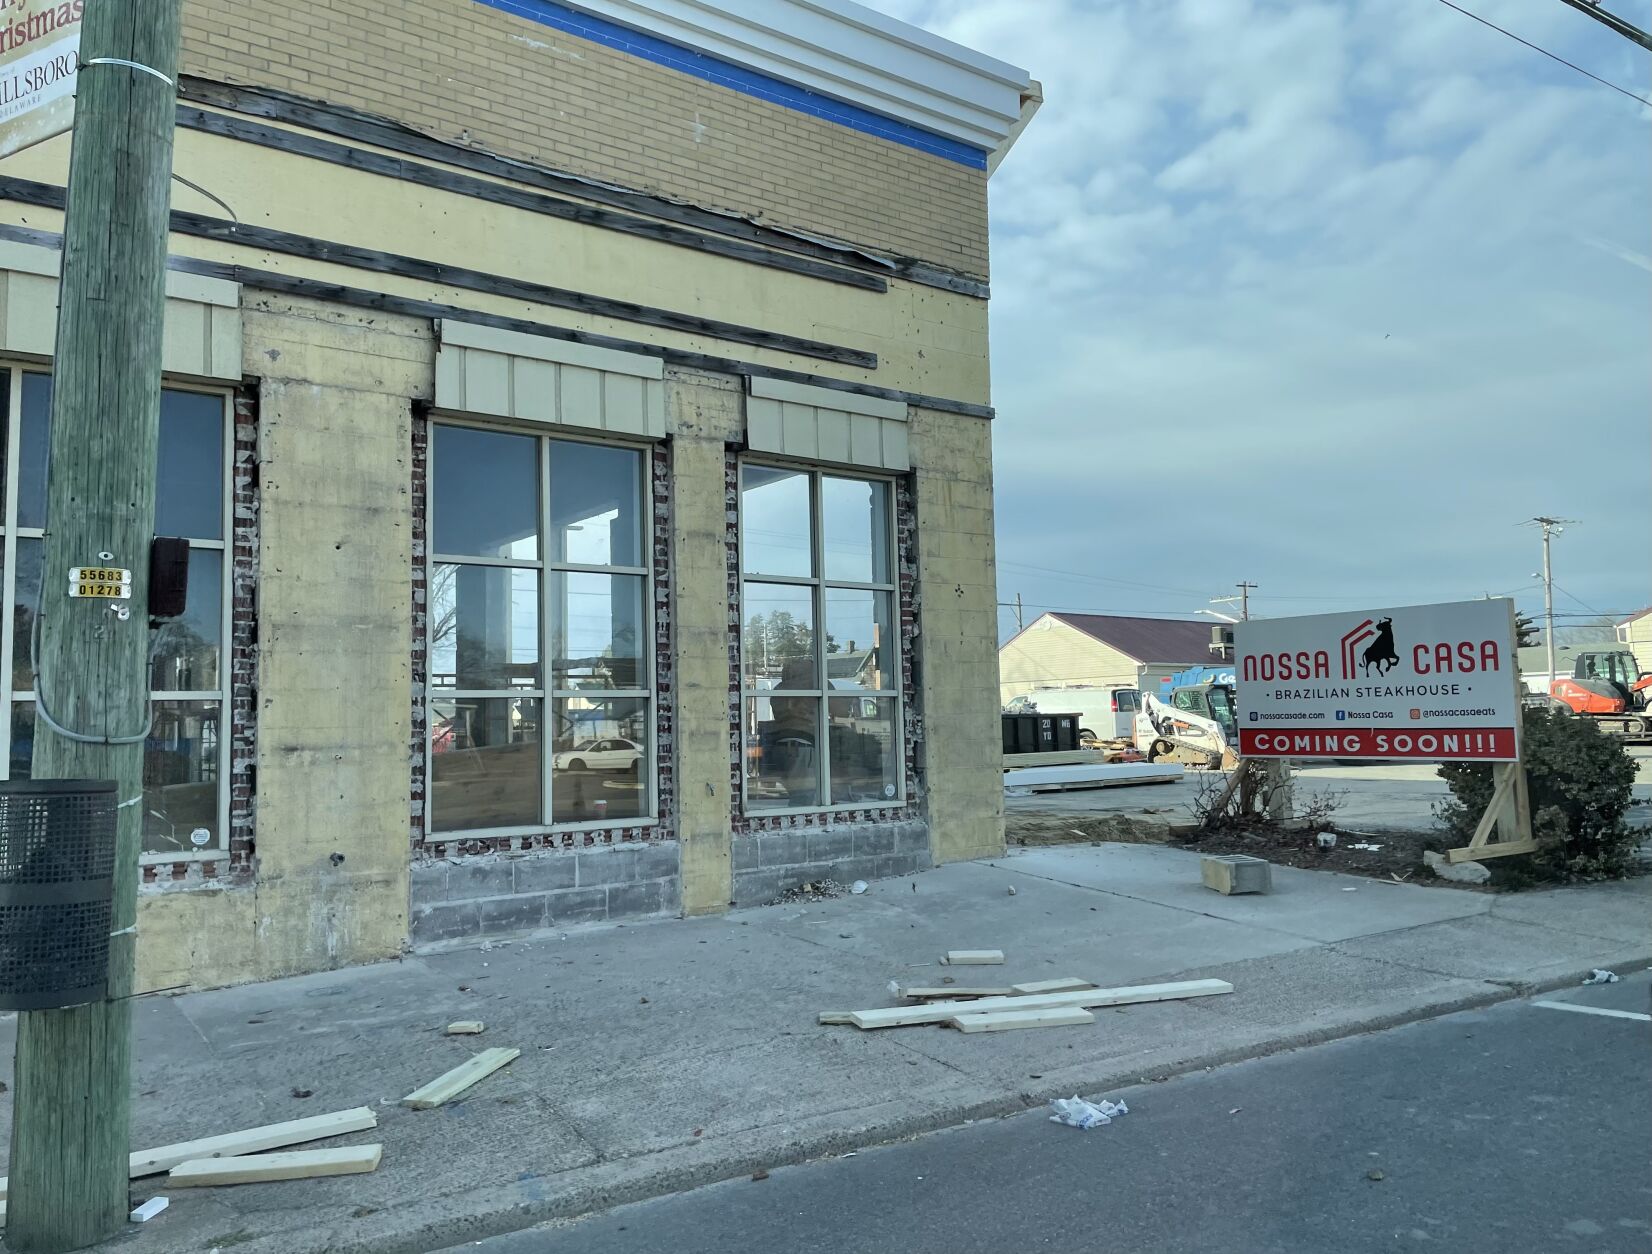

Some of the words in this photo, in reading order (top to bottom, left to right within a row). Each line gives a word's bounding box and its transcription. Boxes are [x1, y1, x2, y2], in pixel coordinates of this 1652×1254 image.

[80, 569, 122, 581] 55683
[79, 585, 121, 596] 01278
[1243, 650, 1330, 681] NOSSA
[1412, 640, 1499, 675] CASA
[1275, 687, 1350, 700] BRAZILIAN
[1355, 684, 1460, 698] STEAKHOUSE
[1260, 711, 1326, 720] nossacasade.com
[1347, 711, 1371, 719] Nossa
[1372, 710, 1394, 719] Casa
[1422, 707, 1496, 718] @nossacasaeats
[1254, 733, 1361, 752] COMING
[1376, 734, 1496, 753] SOON!!!
